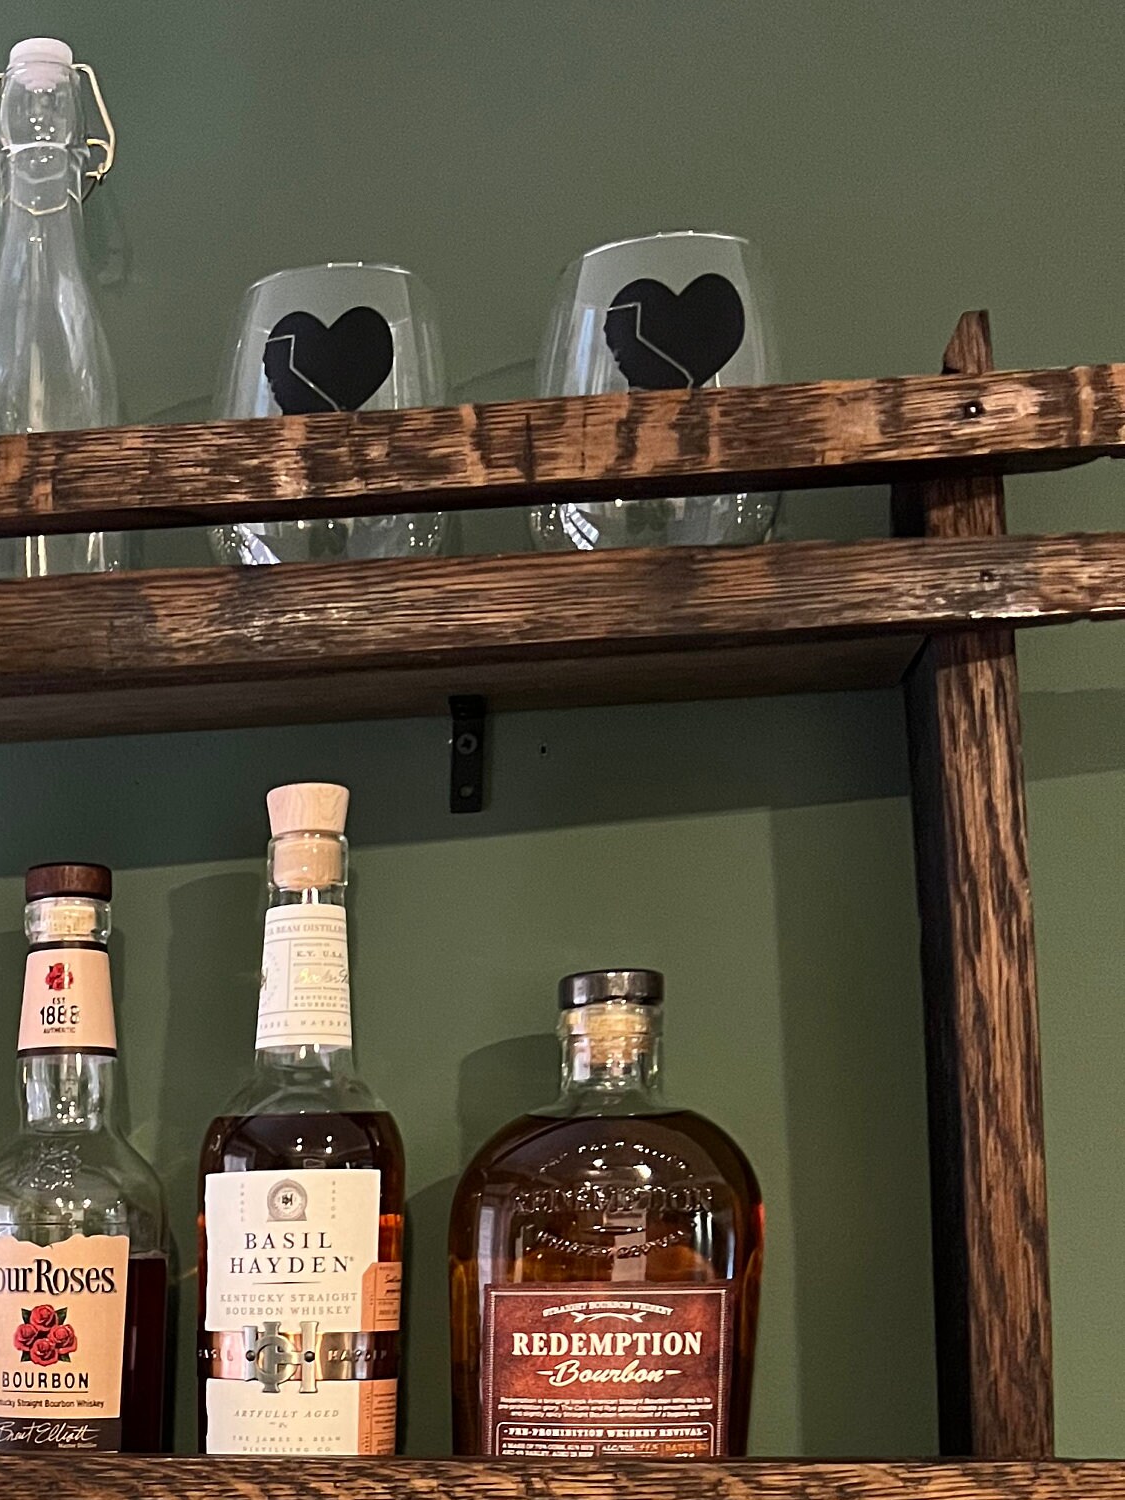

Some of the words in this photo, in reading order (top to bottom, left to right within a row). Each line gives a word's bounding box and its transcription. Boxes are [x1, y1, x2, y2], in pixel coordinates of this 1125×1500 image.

[39, 1005, 81, 1025] 1888
[244, 1231, 332, 1250] BASIL
[229, 1255, 349, 1274] HAYDEN
[33, 1258, 115, 1296] Roses
[219, 1293, 285, 1303] KENTUCKY
[290, 1292, 358, 1302] STRAIGHT
[225, 1306, 284, 1316] BOURBON
[290, 1305, 352, 1315] WHISKEY
[511, 1331, 703, 1356] REDEMPTION
[1, 1371, 89, 1389] BOURBON
[548, 1359, 665, 1387] Bourbon
[17, 1398, 43, 1409] Straight
[44, 1399, 75, 1408] Bourbon
[76, 1399, 105, 1409] Whiskey
[233, 1409, 299, 1418] ARTFULLY
[304, 1409, 340, 1418] AGED
